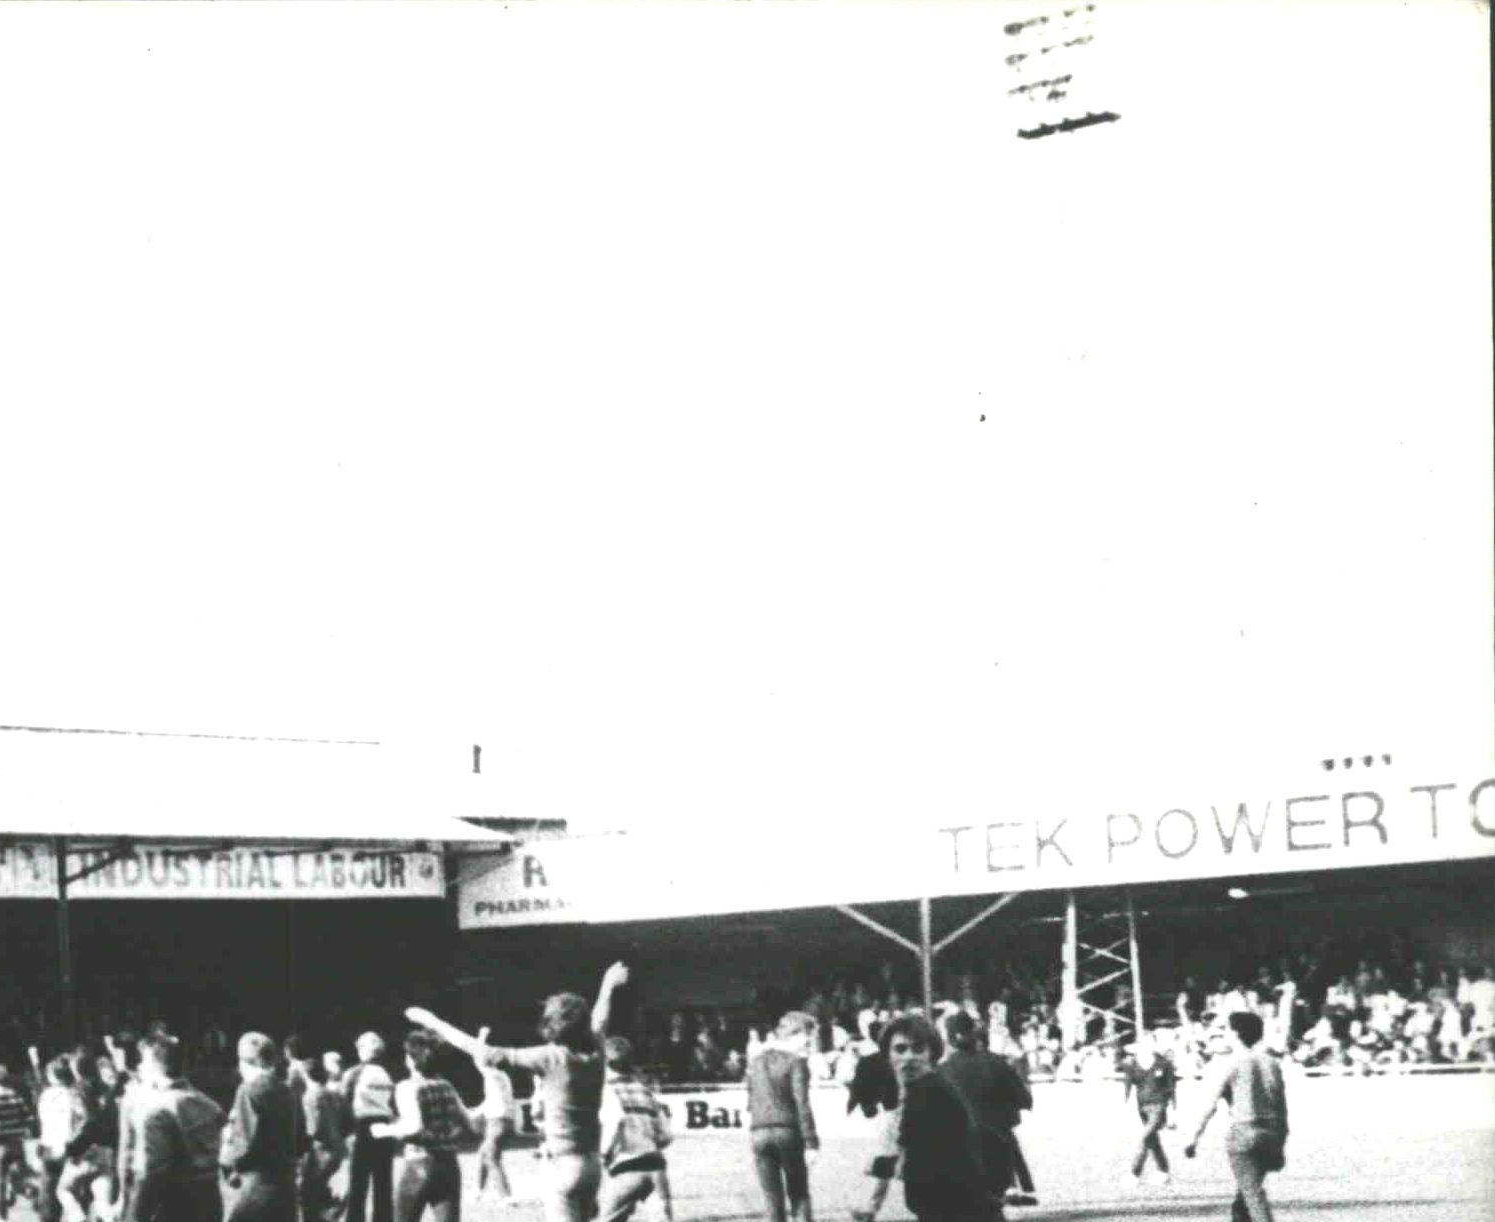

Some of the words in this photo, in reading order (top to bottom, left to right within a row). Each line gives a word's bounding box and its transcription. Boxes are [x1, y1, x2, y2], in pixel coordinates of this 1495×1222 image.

[938, 817, 1074, 873] TEK
[1107, 790, 1388, 864] POWER
[293, 851, 405, 889] LABOUR
